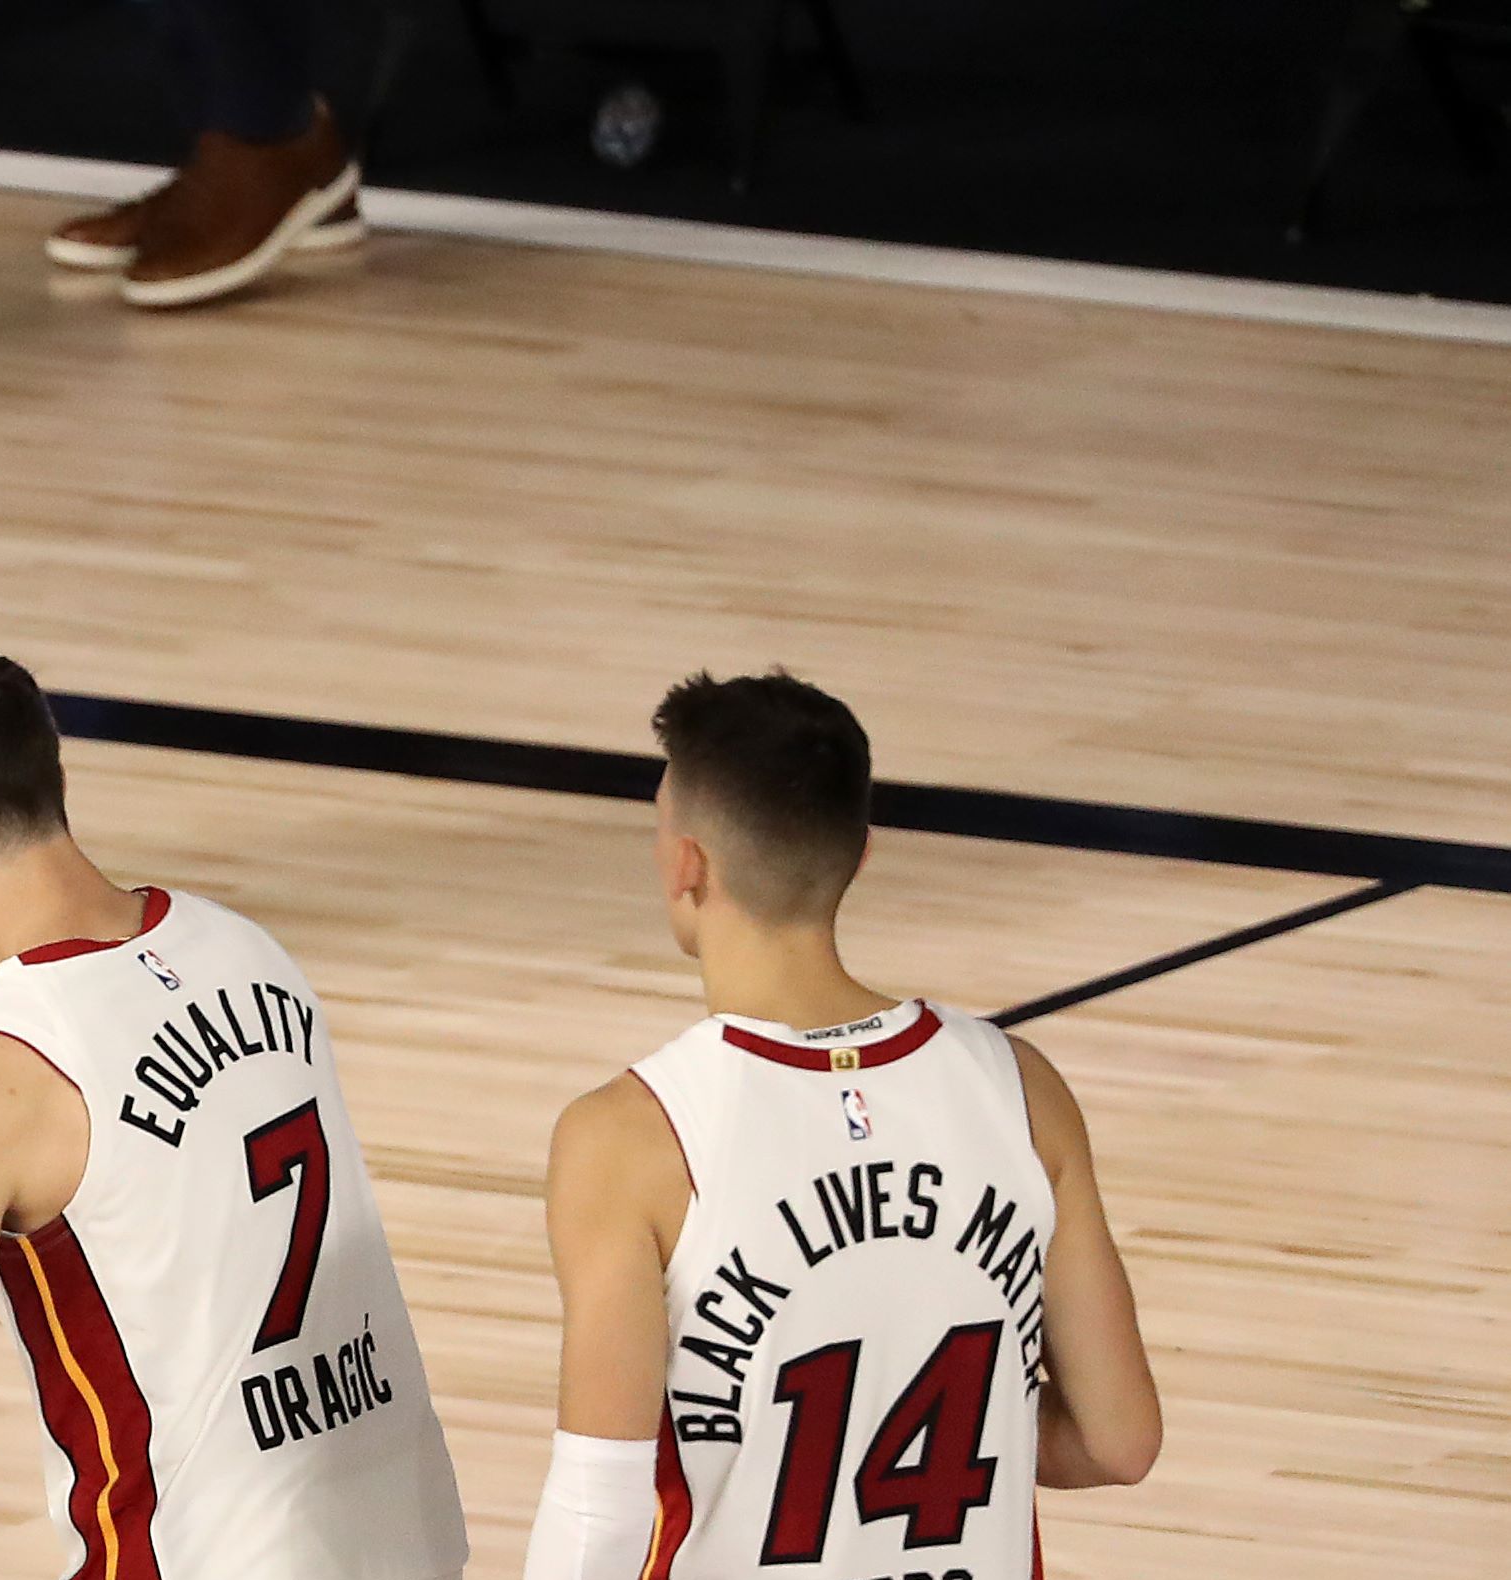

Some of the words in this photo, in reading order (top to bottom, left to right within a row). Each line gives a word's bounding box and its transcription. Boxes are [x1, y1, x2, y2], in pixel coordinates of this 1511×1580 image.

[119, 983, 313, 1148] EQUALITY
[244, 1097, 330, 1354] 7
[671, 1248, 790, 1445] BLACK
[777, 1161, 943, 1268] LIVES
[241, 1314, 392, 1451] DRAGIĆ
[759, 1320, 1004, 1566] 14
